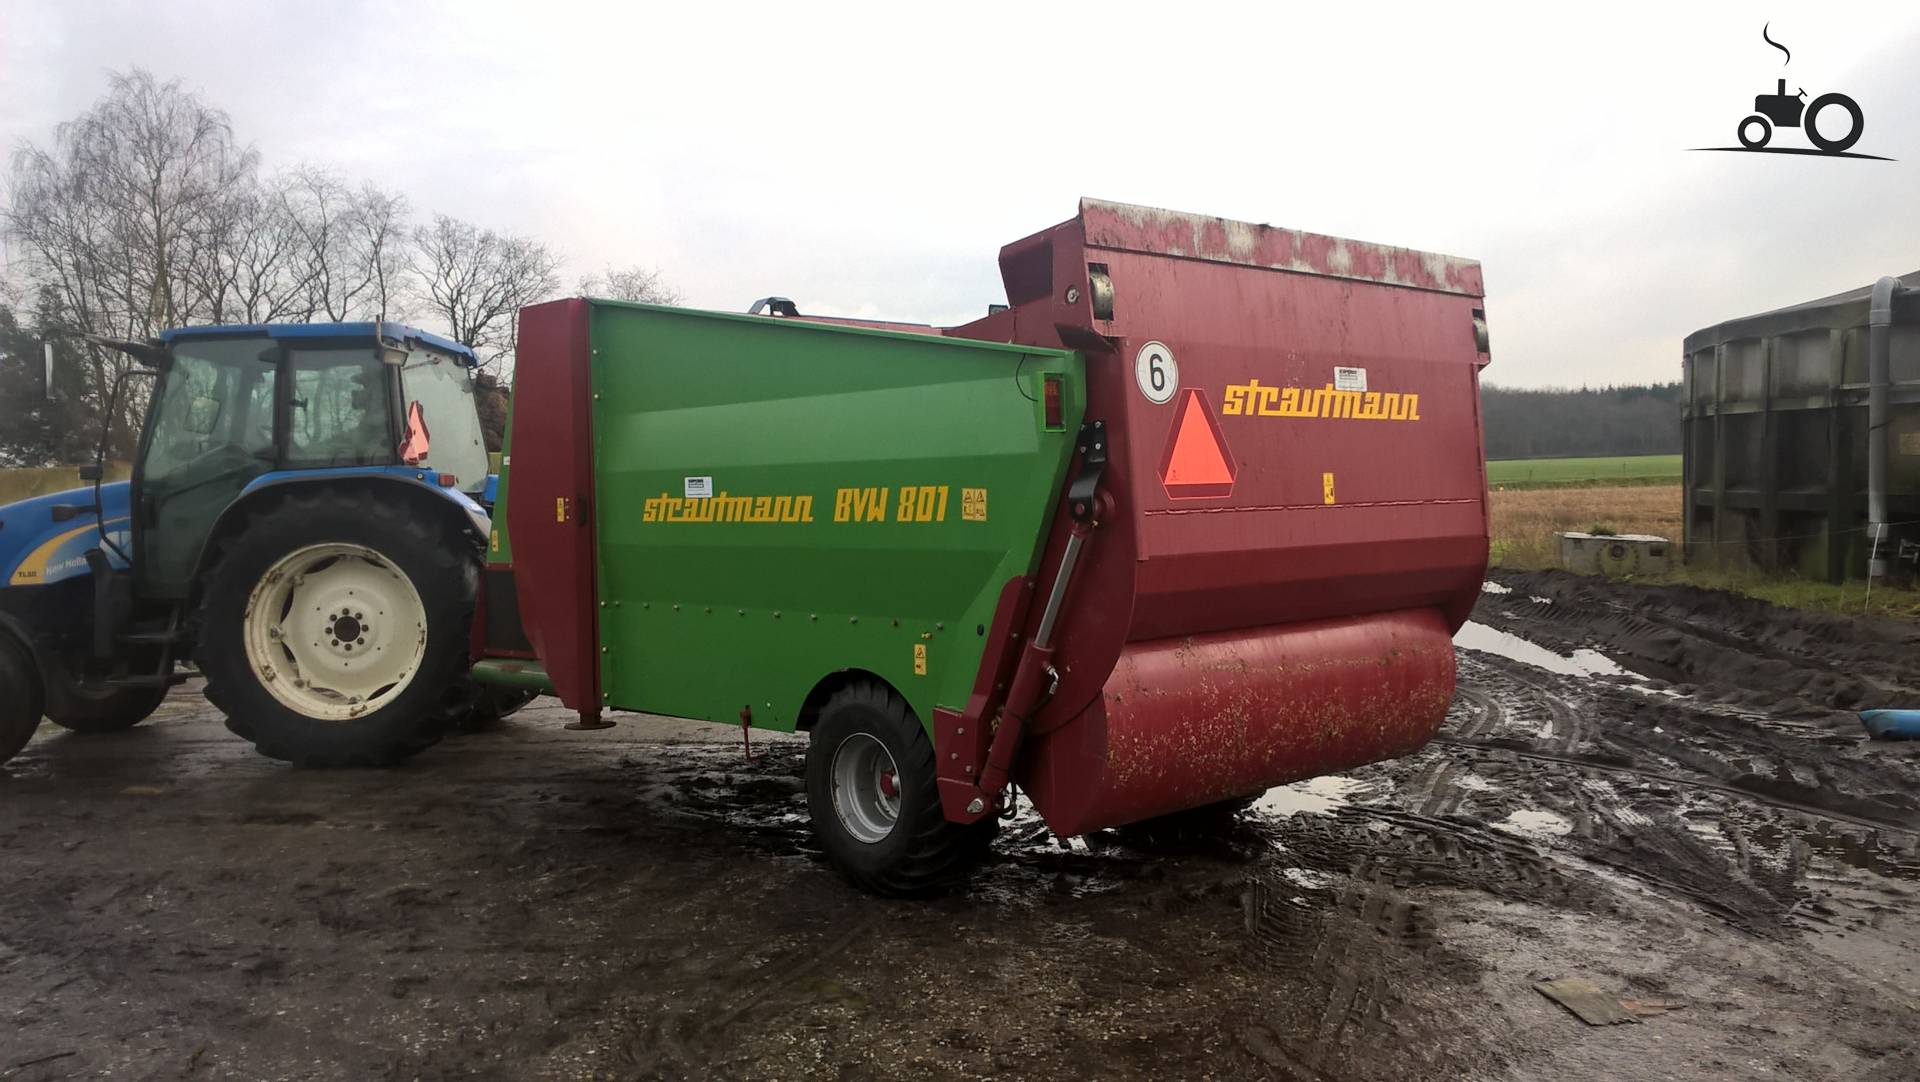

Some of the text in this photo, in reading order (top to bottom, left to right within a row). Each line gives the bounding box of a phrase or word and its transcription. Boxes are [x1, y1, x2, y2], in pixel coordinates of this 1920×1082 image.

[1149, 353, 1165, 391] 6
[1222, 378, 1420, 421] strautmann
[642, 486, 949, 522] strautmann BVW 801
[65, 556, 87, 569] Holla
